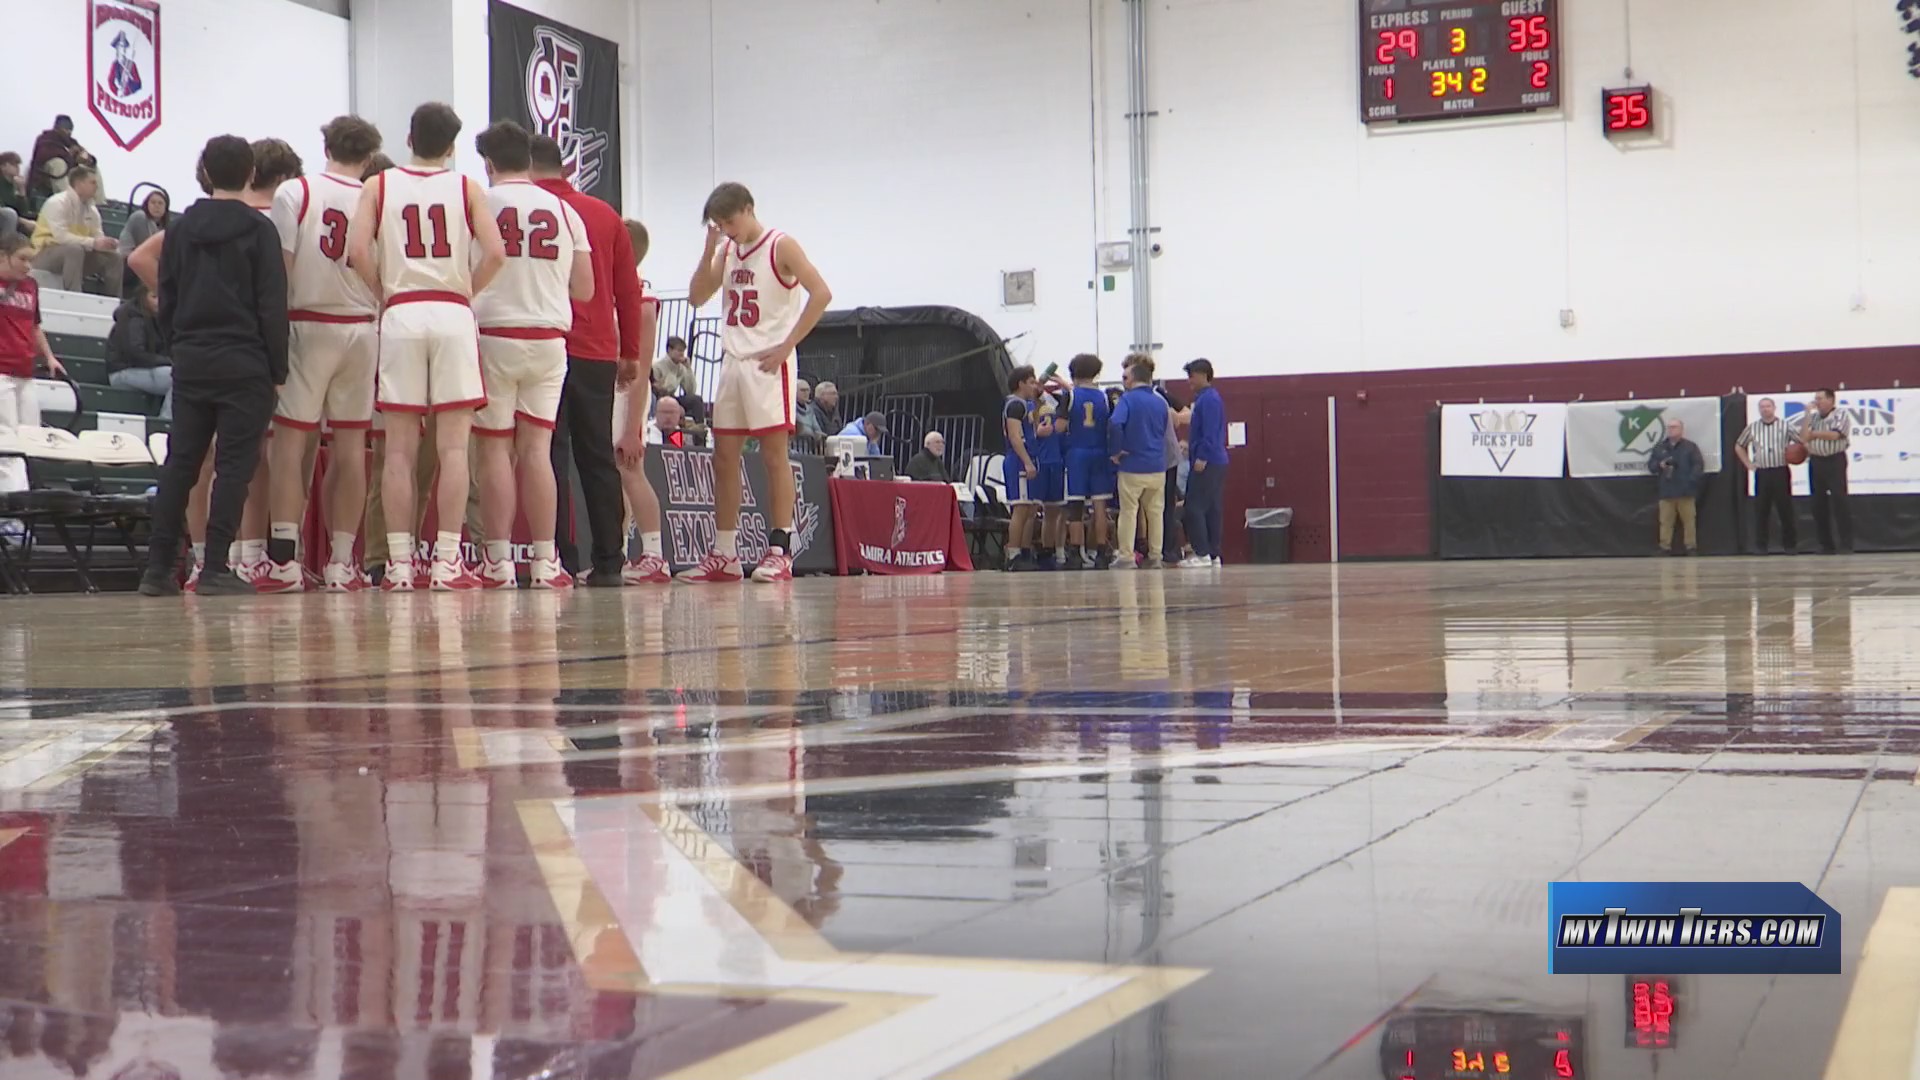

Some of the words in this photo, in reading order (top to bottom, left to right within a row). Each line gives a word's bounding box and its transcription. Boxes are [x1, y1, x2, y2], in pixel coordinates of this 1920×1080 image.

[1370, 10, 1429, 29] EXPRESS
[1440, 8, 1473, 20] PERIOD
[1501, 0, 1545, 16] GUEST
[1450, 27, 1466, 54] 3
[1509, 16, 1549, 51] 35
[1377, 28, 1418, 65] 29
[1521, 50, 1549, 62] FOULS
[1368, 64, 1395, 76] FOULS
[1423, 58, 1455, 71] PLAYER
[1464, 55, 1487, 67] FOUL
[1531, 61, 1549, 88] 2
[1384, 77, 1394, 100] 1
[1430, 70, 1463, 97] 34
[1469, 67, 1488, 94] 2
[96, 80, 153, 119] PATRIOTS
[1368, 105, 1397, 117] SCORE
[1443, 98, 1475, 111] MATCH
[1609, 93, 1648, 130] 35
[320, 208, 352, 267] 3
[402, 203, 452, 258] 11
[497, 206, 558, 260] 42
[726, 289, 760, 327] 25
[1083, 401, 1095, 428] 1
[1628, 417, 1641, 430] K
[1784, 398, 1895, 426] DNN
[1510, 434, 1533, 448] PUB
[1646, 431, 1658, 443] V
[1851, 426, 1895, 437] ROUP
[661, 450, 756, 507] ELMA
[859, 543, 892, 564] LMIRA
[894, 550, 945, 566] ATHLETICS
